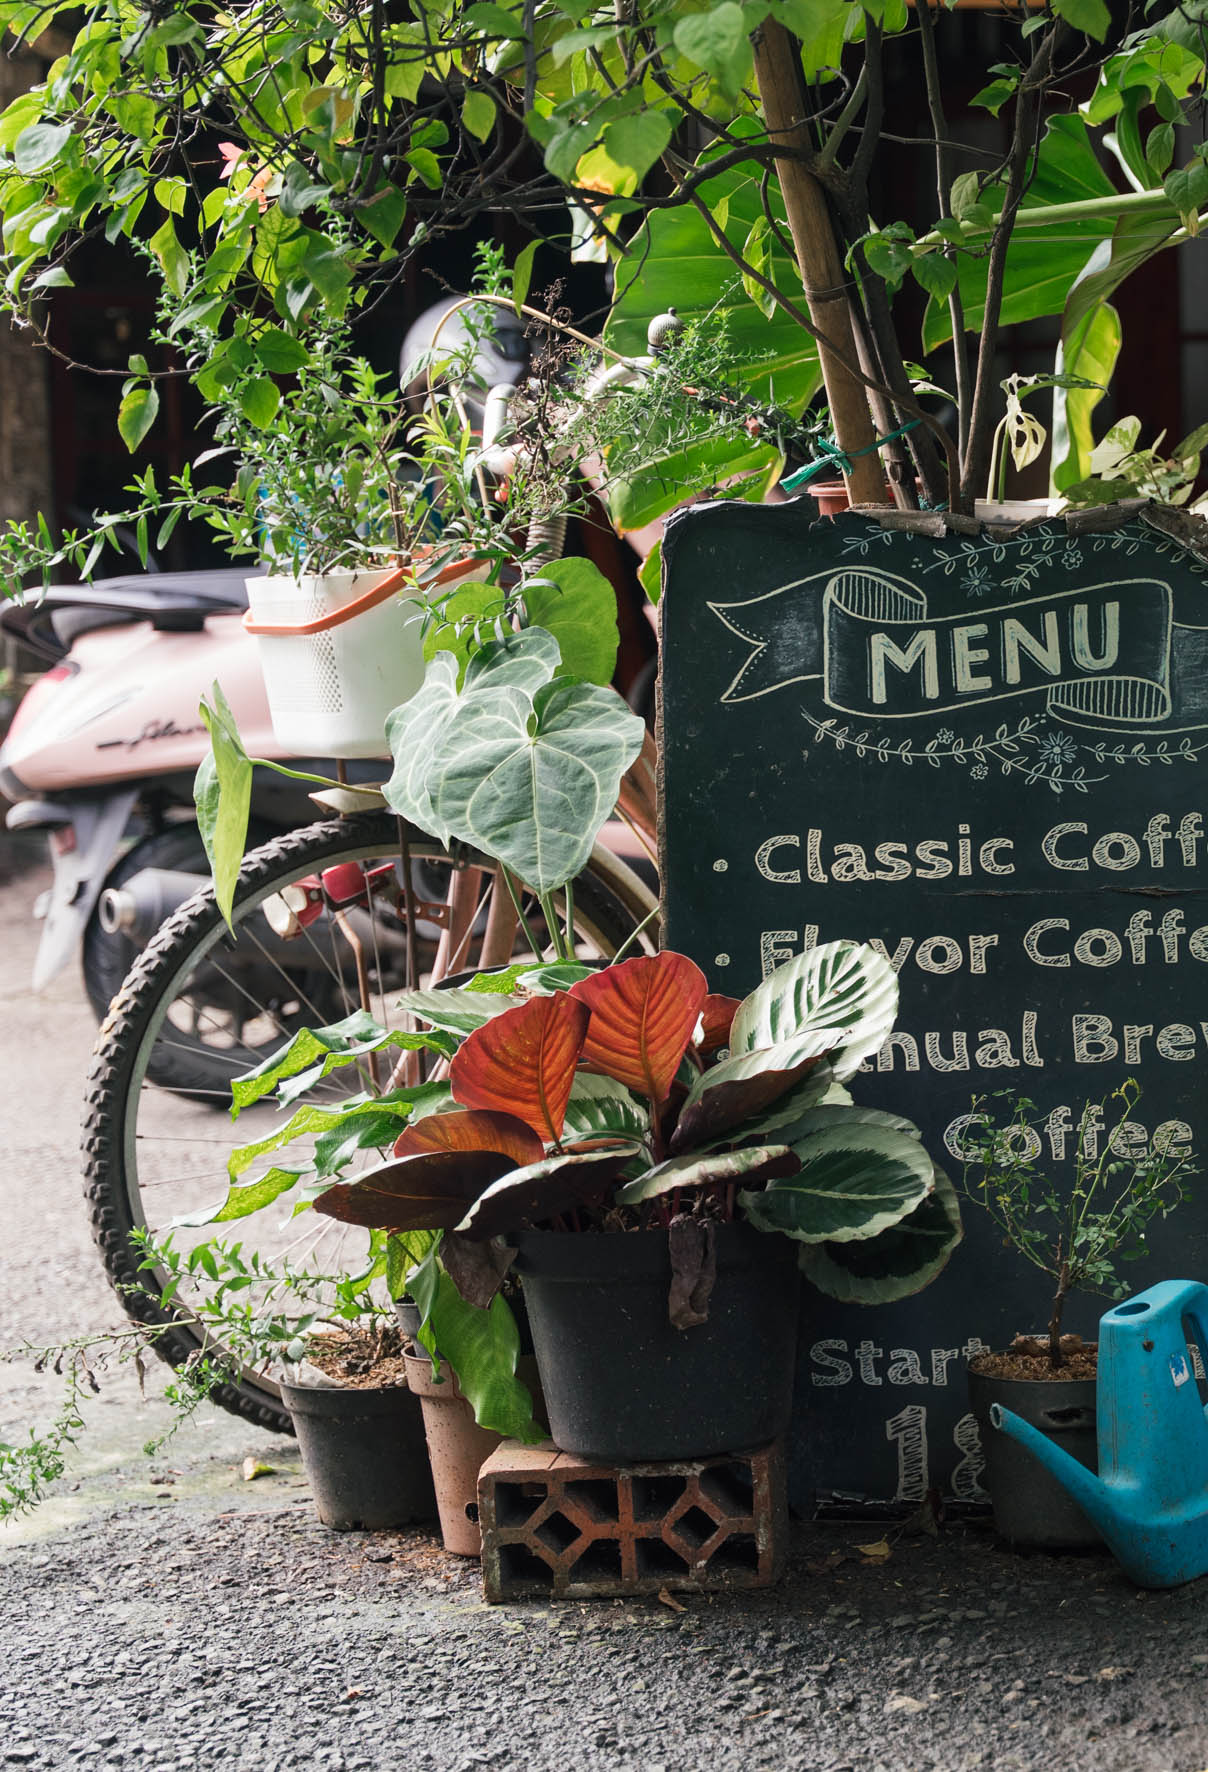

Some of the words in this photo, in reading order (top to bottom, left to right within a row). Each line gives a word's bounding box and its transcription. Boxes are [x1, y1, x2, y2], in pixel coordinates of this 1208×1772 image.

[864, 600, 1121, 705] MENU
[754, 823, 1016, 884] Classic
[857, 1011, 1044, 1073] nual
[942, 1104, 1194, 1164] Coffee
